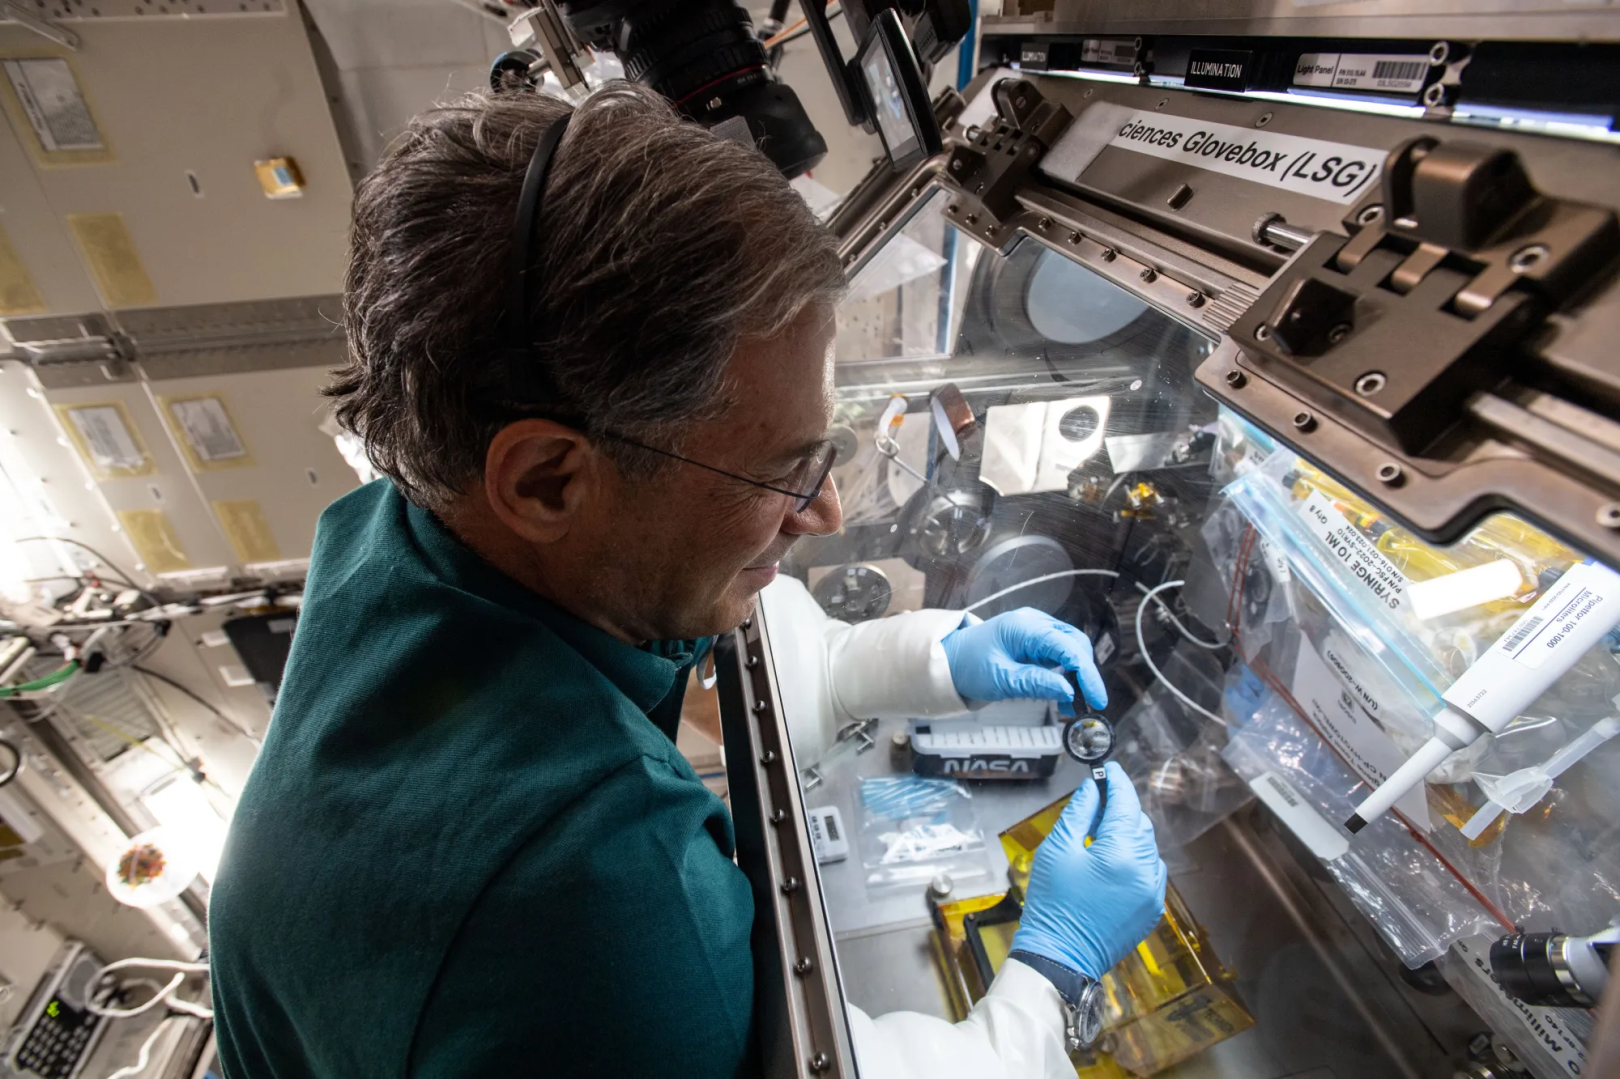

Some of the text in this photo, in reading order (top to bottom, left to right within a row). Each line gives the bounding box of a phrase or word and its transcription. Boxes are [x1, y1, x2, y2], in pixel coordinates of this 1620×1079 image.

[1190, 61, 1243, 78] ILLUMINATION
[1297, 65, 1335, 76] Light Panel
[1118, 119, 1378, 198] ciences Glovebox (LSG)
[1315, 510, 1328, 524] Qty
[1325, 531, 1400, 609] SYRINGE 10 ML
[1391, 571, 1403, 582] S/N
[1387, 579, 1402, 594] P/N
[1556, 590, 1593, 622] Microliters
[1575, 594, 1604, 621] Pipettor
[1546, 621, 1577, 649] 100-1000
[943, 759, 1029, 775] NASA
[1474, 957, 1563, 1053] Millimers
